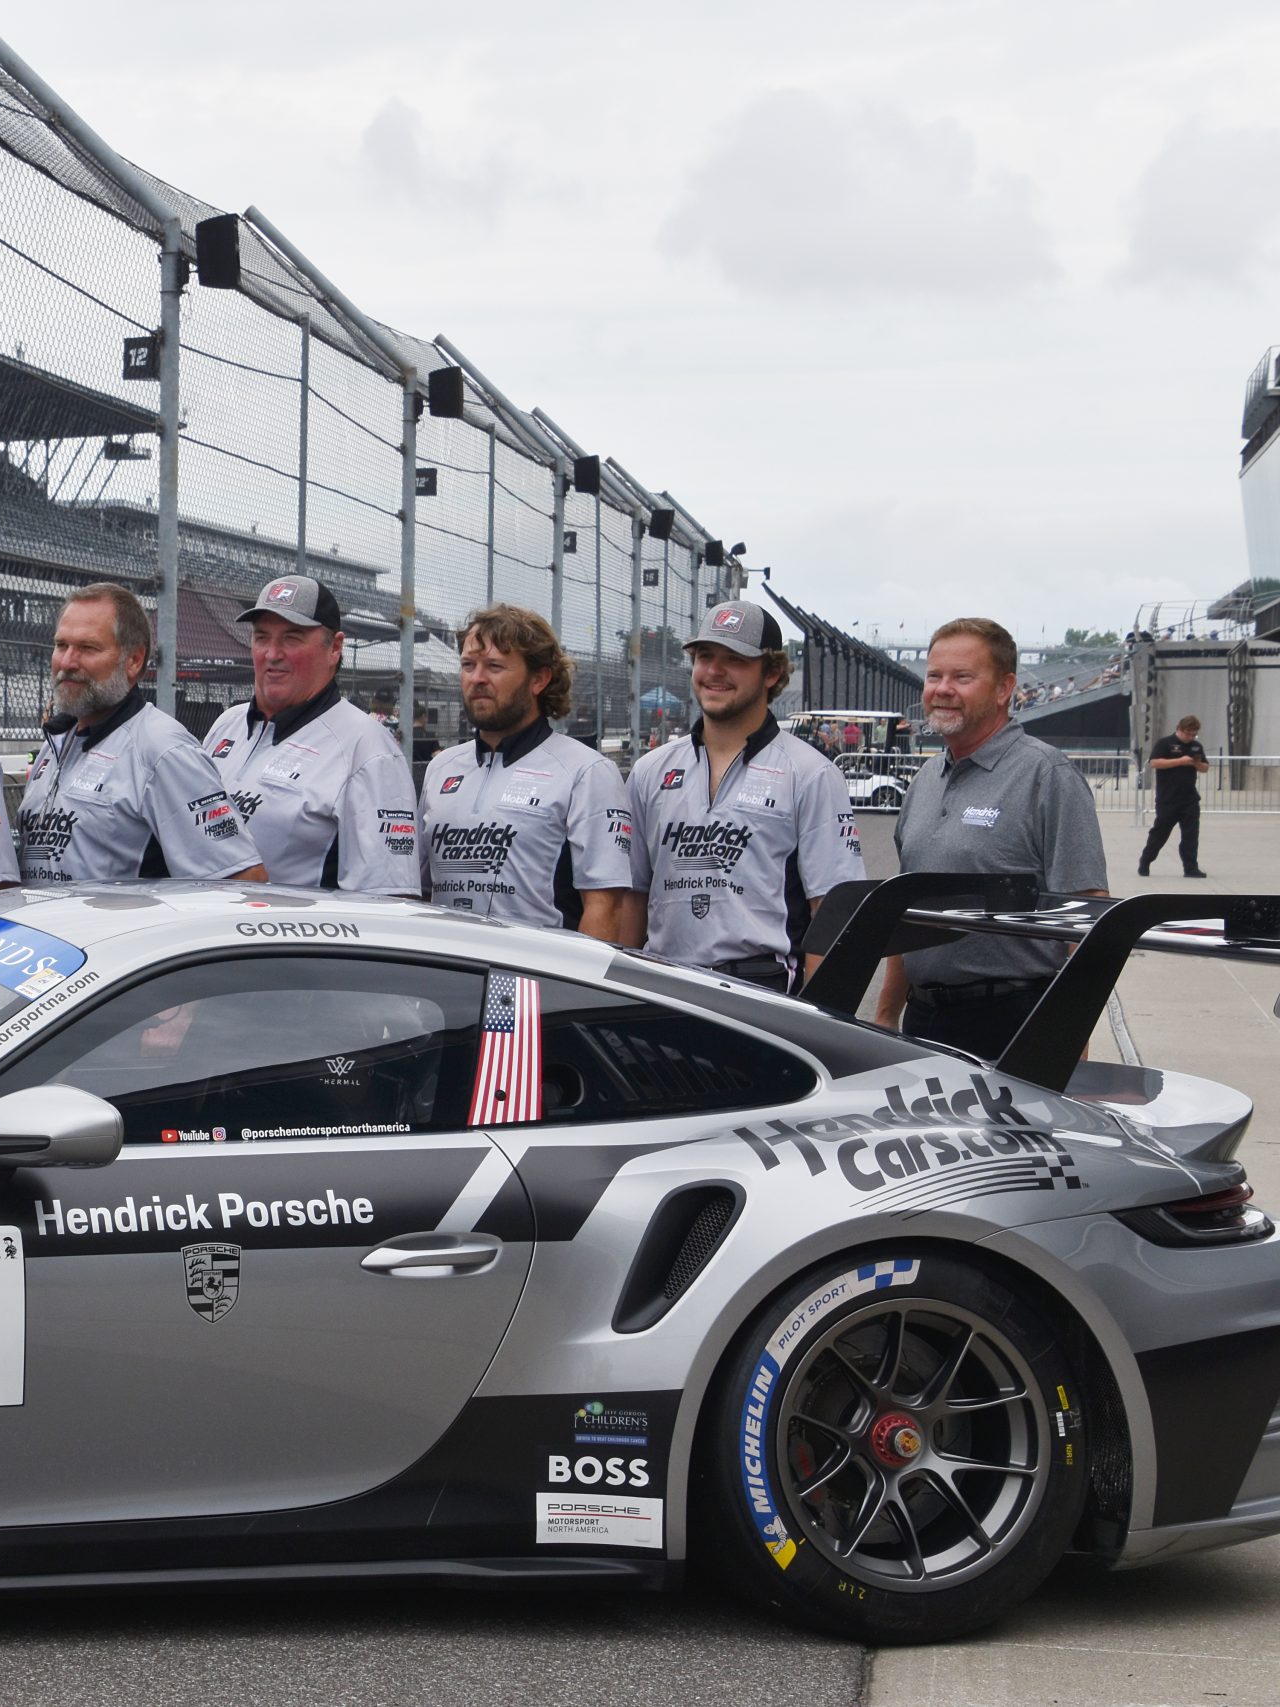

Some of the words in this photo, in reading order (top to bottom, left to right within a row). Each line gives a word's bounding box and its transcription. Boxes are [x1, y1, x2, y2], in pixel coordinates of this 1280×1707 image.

[130, 347, 148, 366] 12
[431, 822, 518, 853] Hendrick
[661, 820, 752, 852] Hendrick
[442, 845, 508, 861] cars.com
[467, 880, 516, 895] Porsche
[664, 877, 703, 891] Hendrick
[235, 922, 360, 938] GORDON
[241, 1122, 411, 1140] @porschemotorsportnorthamerica
[732, 1073, 1032, 1176] Hendrick
[178, 1130, 210, 1141] YouTube
[837, 1129, 1068, 1192] Cars.com
[35, 1194, 213, 1236] Hendrick
[218, 1189, 375, 1228] Porsche
[184, 1246, 240, 1257] PORSCHE
[777, 1312, 808, 1350] PILOT
[807, 1282, 847, 1317] SPORT
[584, 1414, 648, 1427] CHILDREN'S
[744, 1364, 774, 1514] MICHELIN
[548, 1455, 650, 1487] BOSS
[547, 1503, 641, 1515] PORSCHE
[547, 1518, 600, 1526] MOTORSPORT
